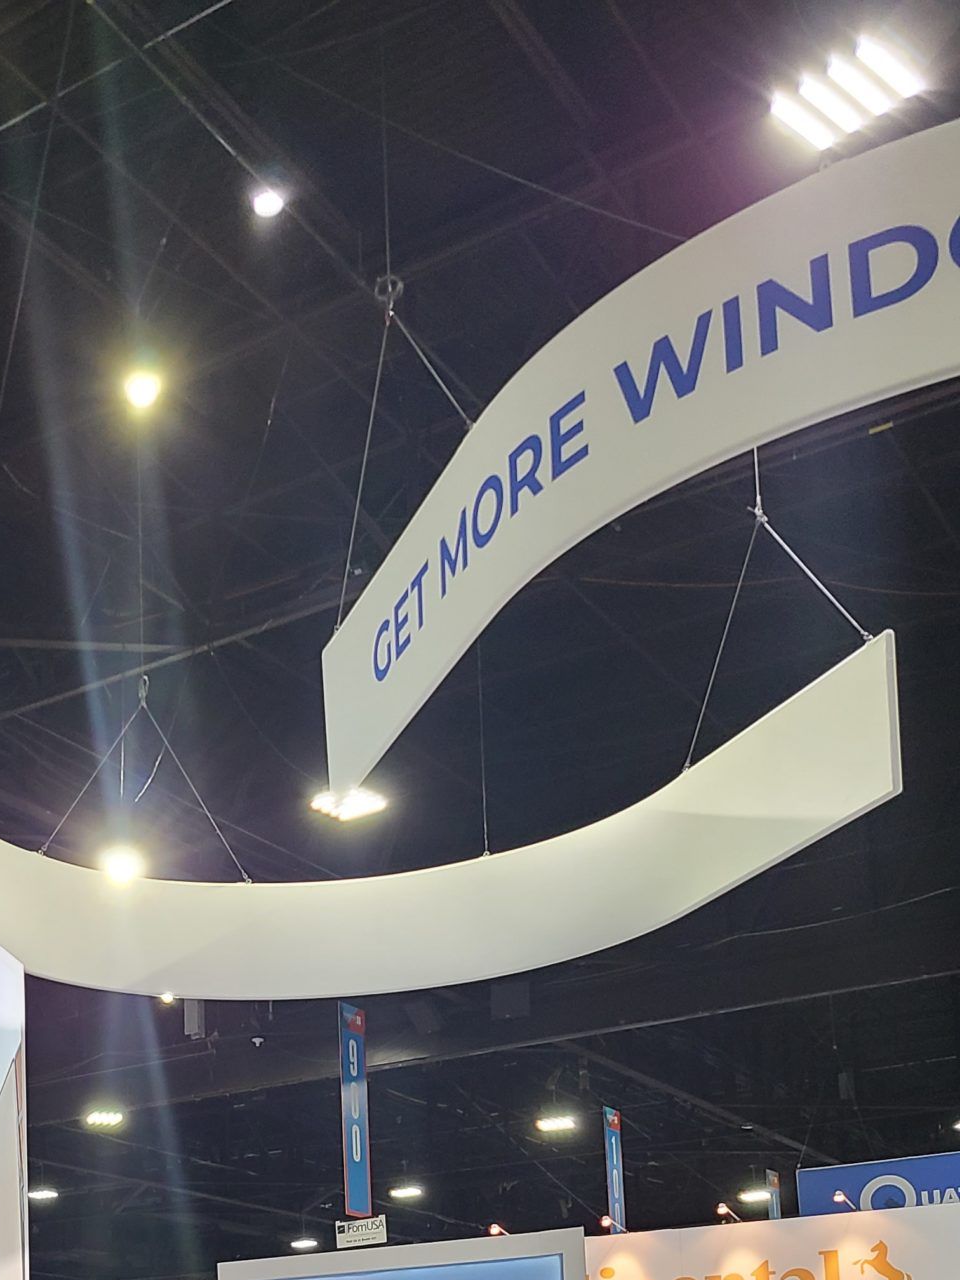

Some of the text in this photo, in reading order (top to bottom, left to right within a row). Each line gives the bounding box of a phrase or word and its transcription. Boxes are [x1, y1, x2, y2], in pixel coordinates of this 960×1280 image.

[372, 215, 960, 682] GET MORE WINDO
